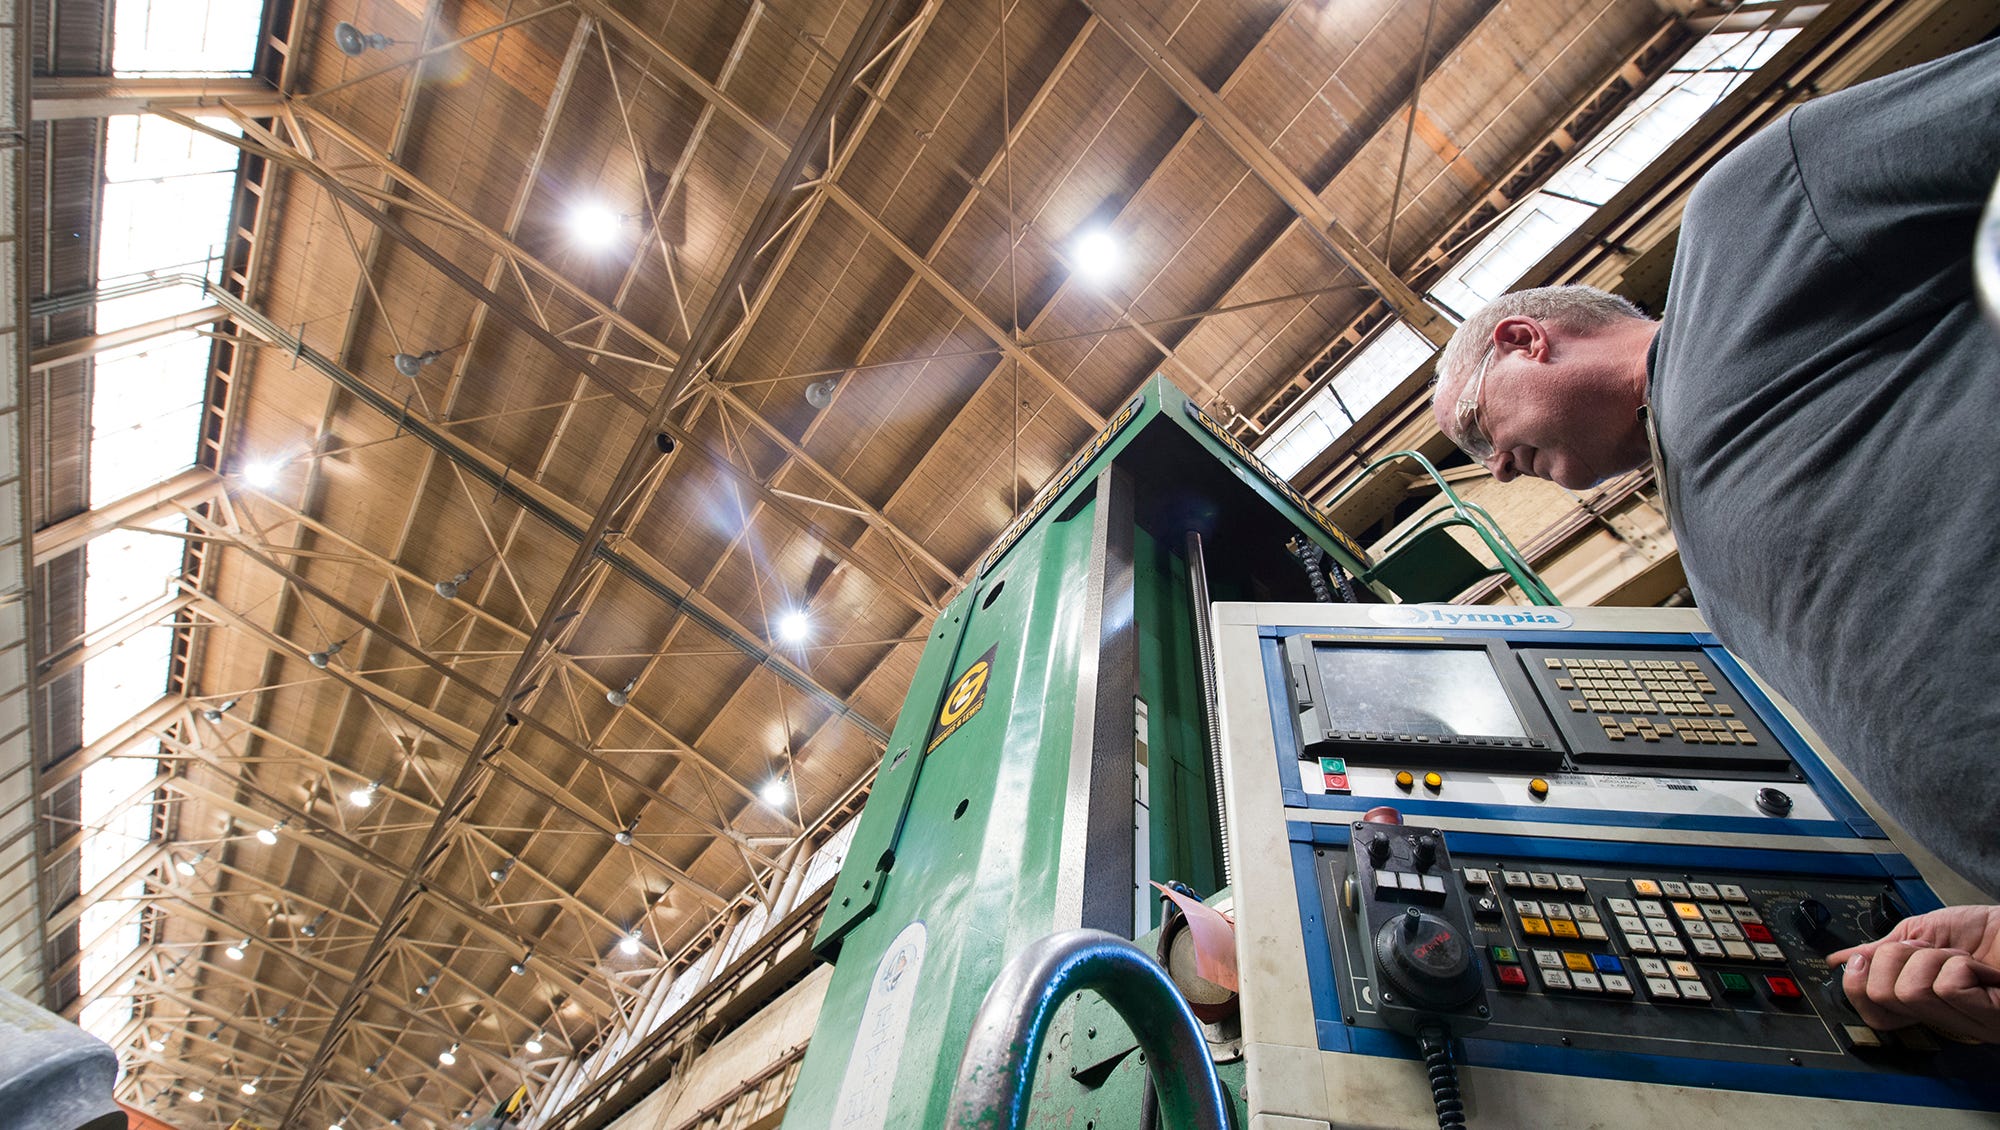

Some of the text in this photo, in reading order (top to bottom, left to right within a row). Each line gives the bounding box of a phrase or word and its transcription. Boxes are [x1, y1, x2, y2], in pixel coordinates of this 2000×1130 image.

[987, 484, 1059, 564] GIDDINGS
[1071, 408, 1132, 476] LEWIS
[1198, 411, 1291, 496] GIDDINGS
[1302, 499, 1366, 561] LEWIS
